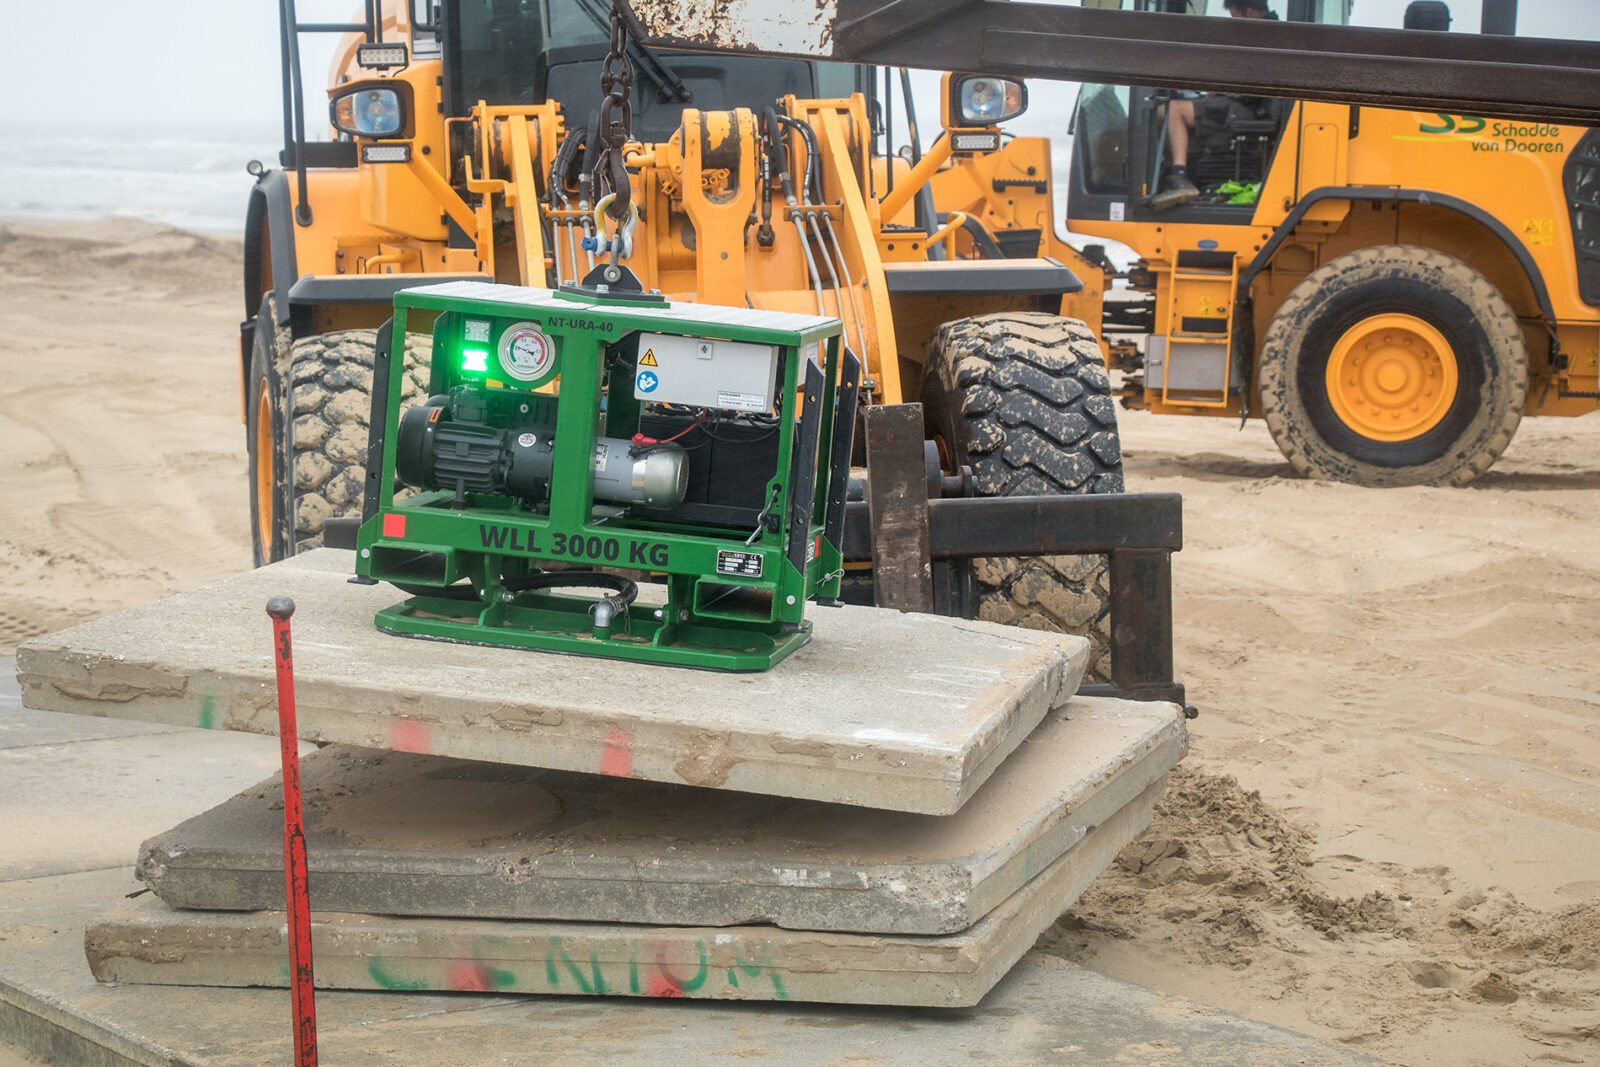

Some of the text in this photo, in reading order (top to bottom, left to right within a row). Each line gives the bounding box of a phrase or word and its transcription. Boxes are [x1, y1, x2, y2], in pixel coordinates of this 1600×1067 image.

[1492, 122, 1560, 137] Schadde
[1471, 138, 1564, 153] van Dooren
[548, 316, 614, 333] NT-URA-40
[479, 524, 669, 567] WLL 3000 KG
